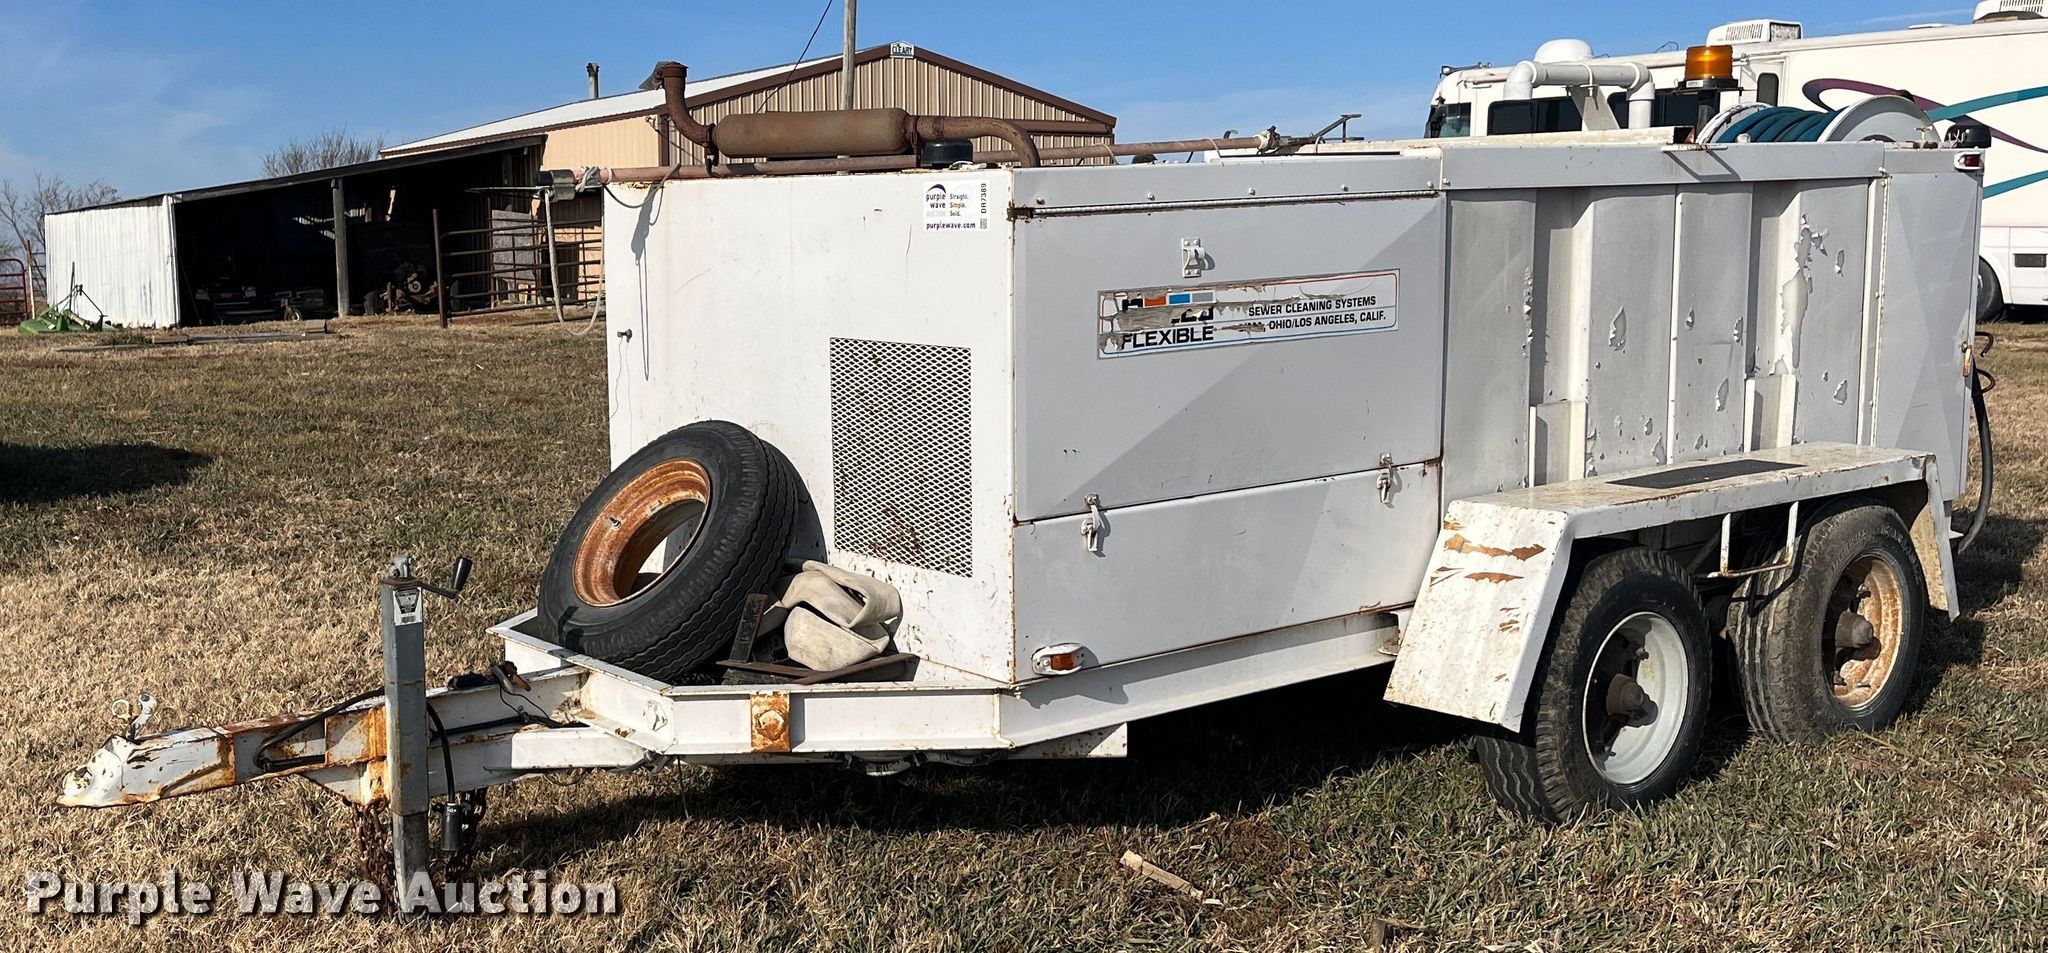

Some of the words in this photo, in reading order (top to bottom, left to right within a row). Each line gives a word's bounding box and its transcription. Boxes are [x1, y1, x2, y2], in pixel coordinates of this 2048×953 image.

[926, 193, 946, 202] purple
[926, 221, 976, 231] purplewave.com
[1249, 304, 1282, 317] SEWER
[1285, 299, 1332, 314] CLEANING
[1333, 295, 1376, 309] SYSTEMS
[1268, 316, 1312, 330] OHIO/LOS
[1314, 313, 1358, 326] ANGELES,
[1359, 310, 1386, 322] CALIF.
[1121, 325, 1214, 350] FLEXIBLE
